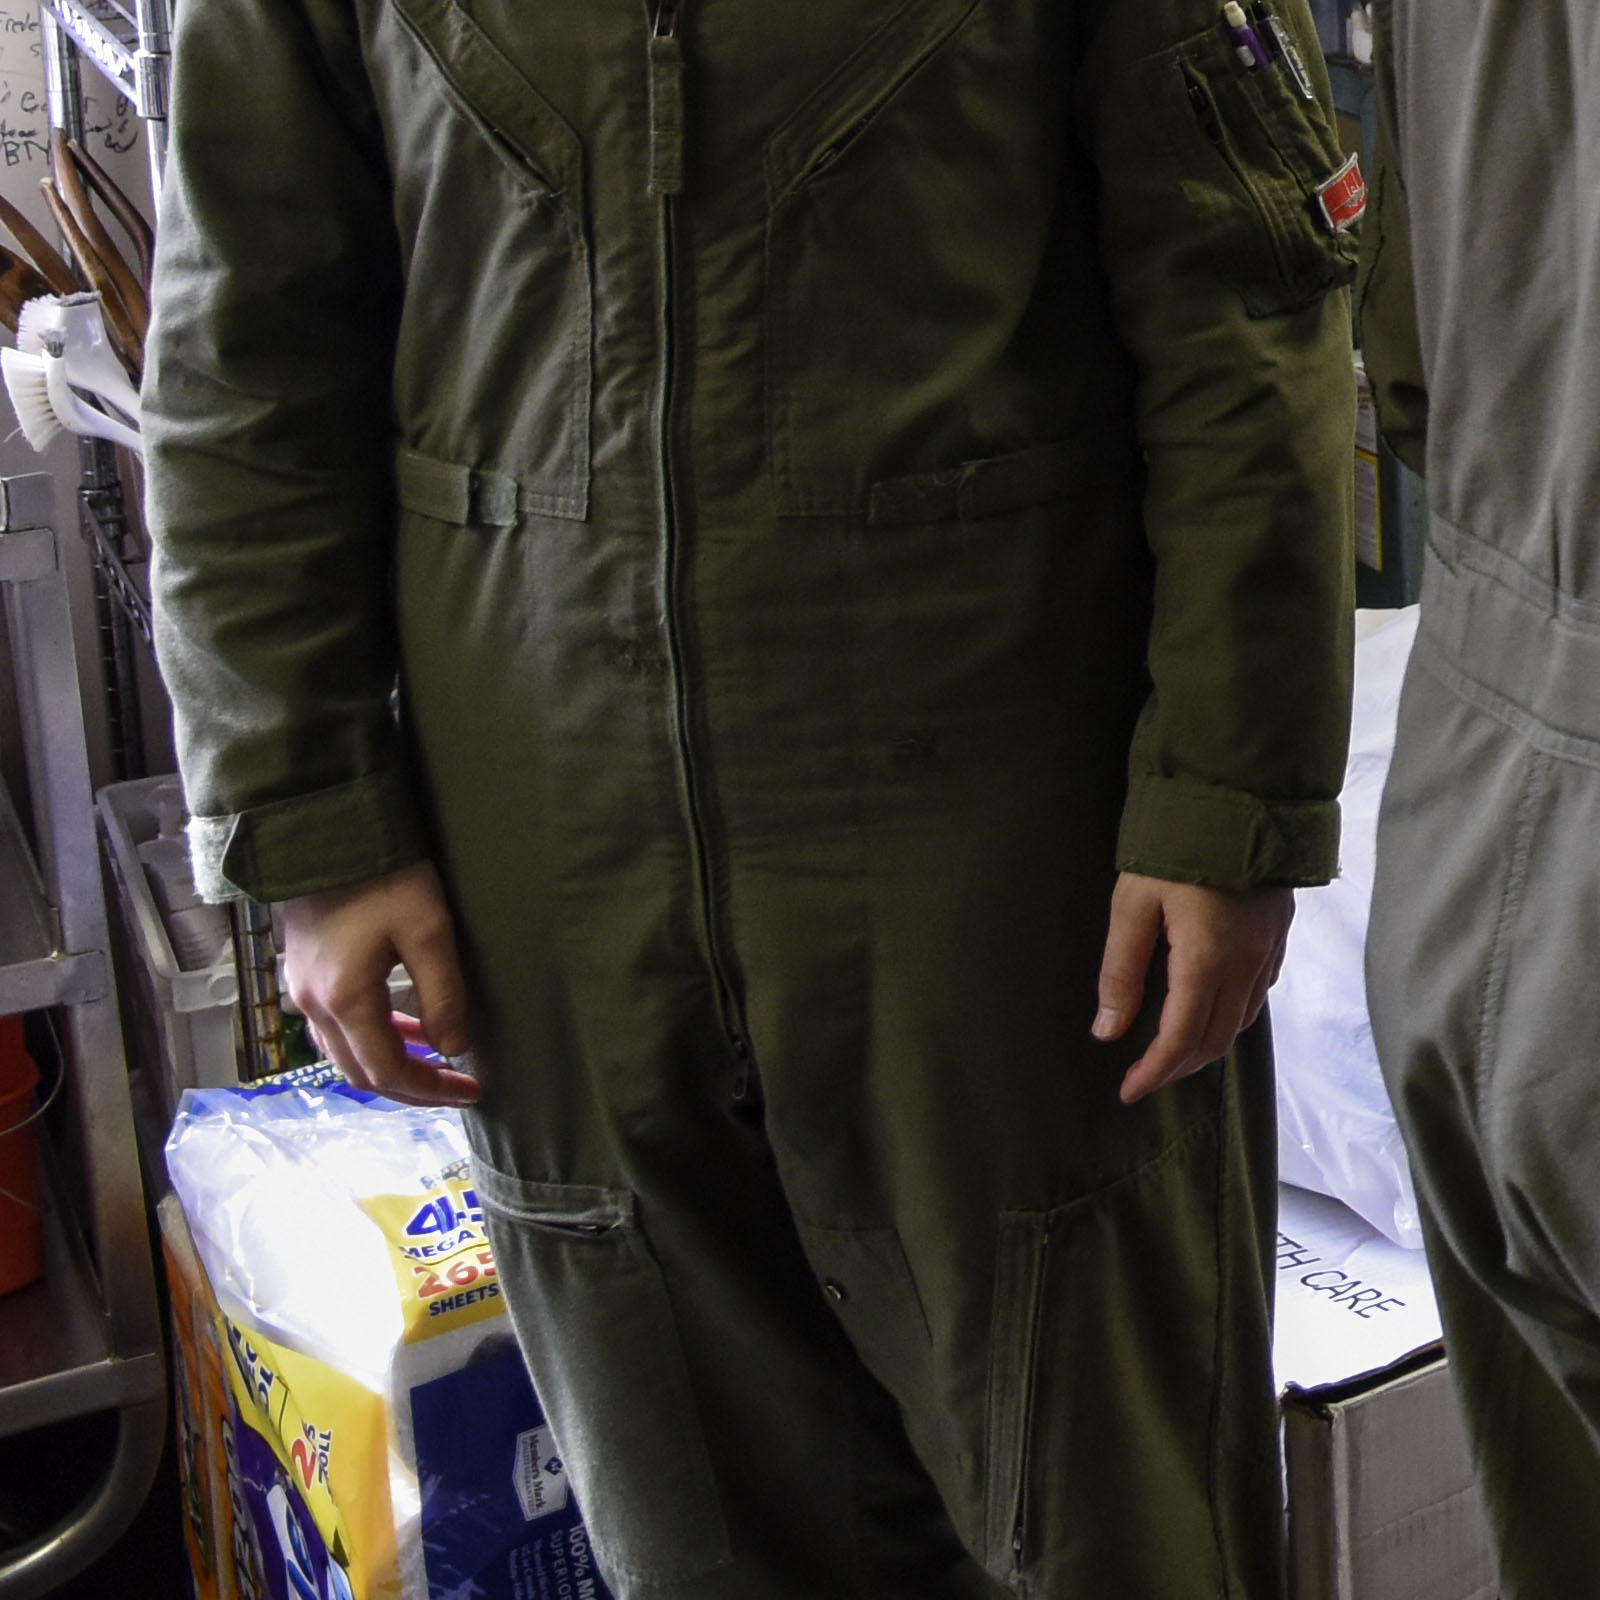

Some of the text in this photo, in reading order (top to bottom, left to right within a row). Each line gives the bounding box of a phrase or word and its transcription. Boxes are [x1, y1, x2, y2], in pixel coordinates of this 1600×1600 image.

[402, 1228, 477, 1259] MEGA
[1277, 1231, 1406, 1319] TH CARE
[429, 1283, 500, 1317] SHEETS
[533, 1480, 546, 1509] Mark
[568, 1522, 591, 1577] 100%
